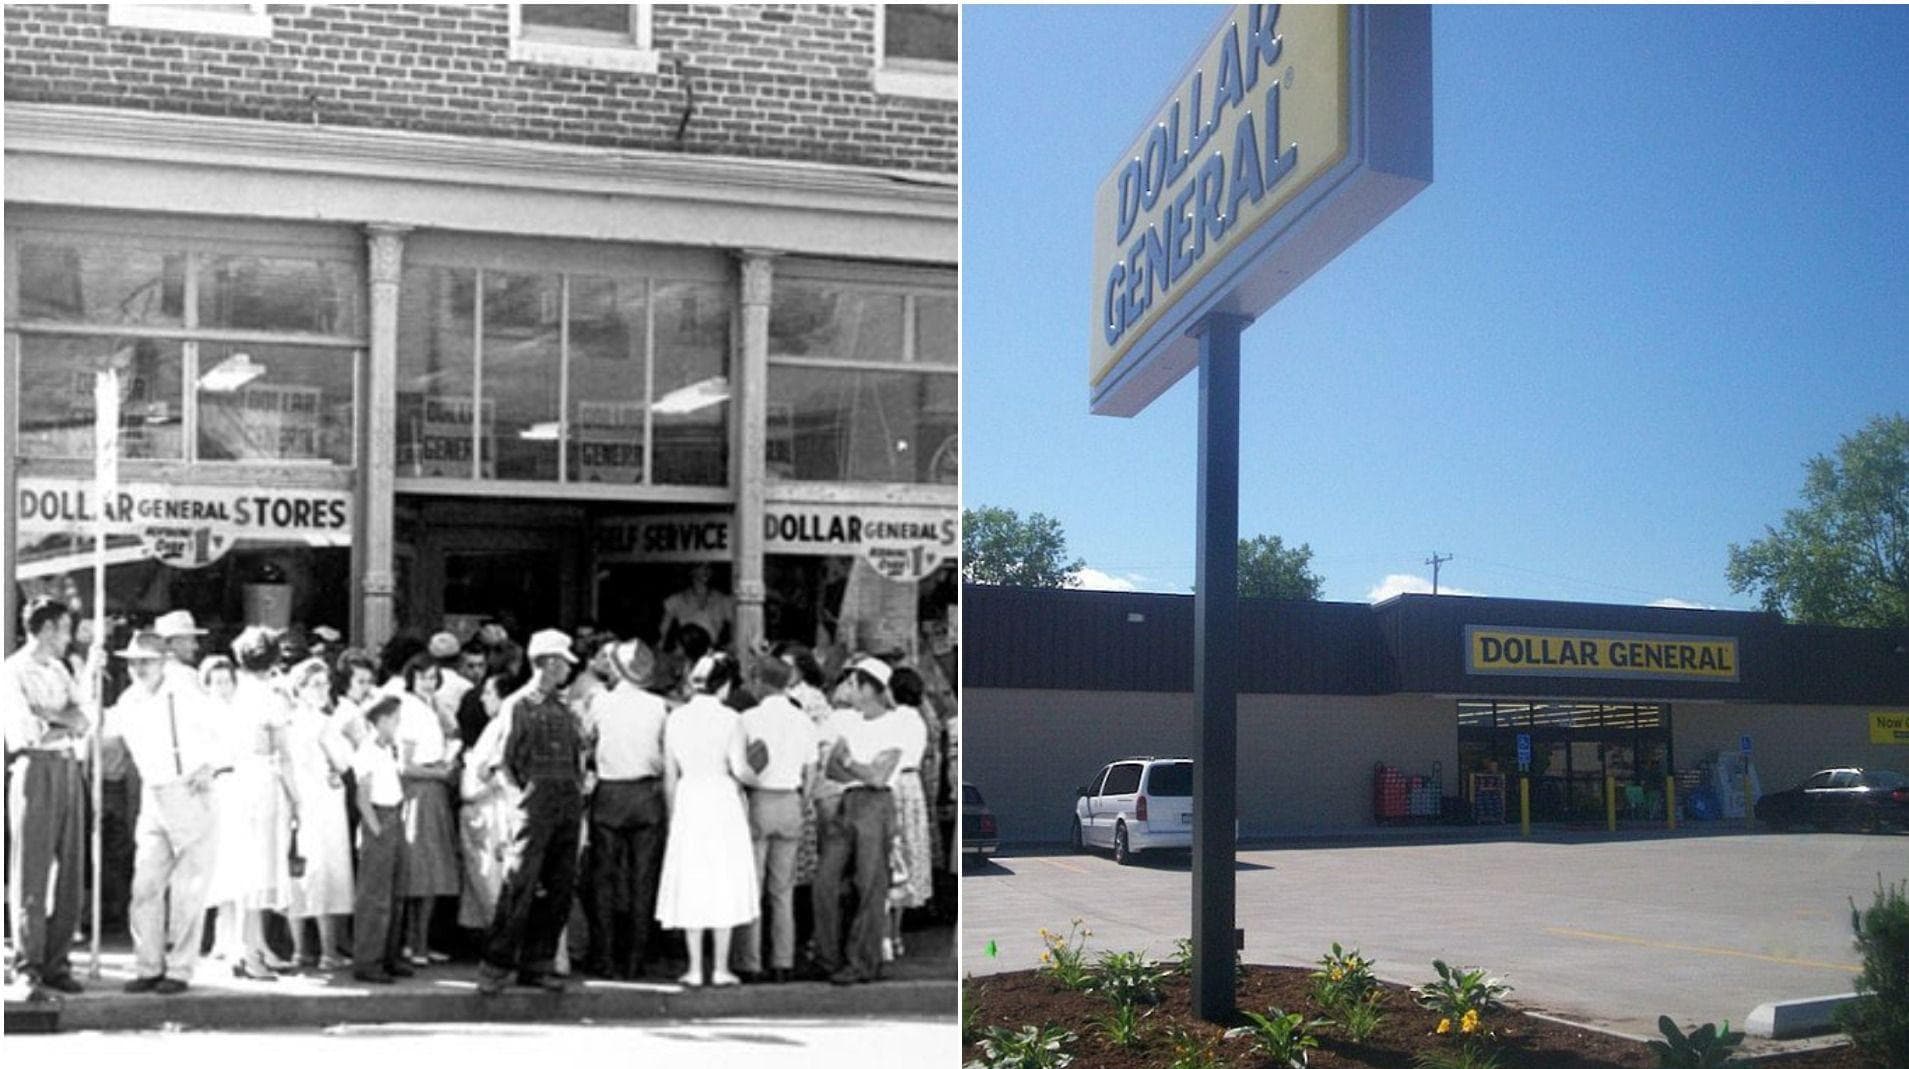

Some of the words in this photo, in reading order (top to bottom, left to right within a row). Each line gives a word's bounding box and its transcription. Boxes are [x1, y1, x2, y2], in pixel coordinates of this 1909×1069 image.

[1117, 4, 1283, 246] DOLLAR
[1104, 80, 1297, 346] GENERAL
[137, 499, 230, 521] GENERAL
[234, 497, 345, 529] STORES
[764, 513, 862, 544] DOLLAR
[864, 520, 939, 540] GENERAL
[645, 522, 728, 551] SERVICE
[1480, 636, 1600, 666] DOLLAR
[1608, 641, 1731, 671] GENERAL
